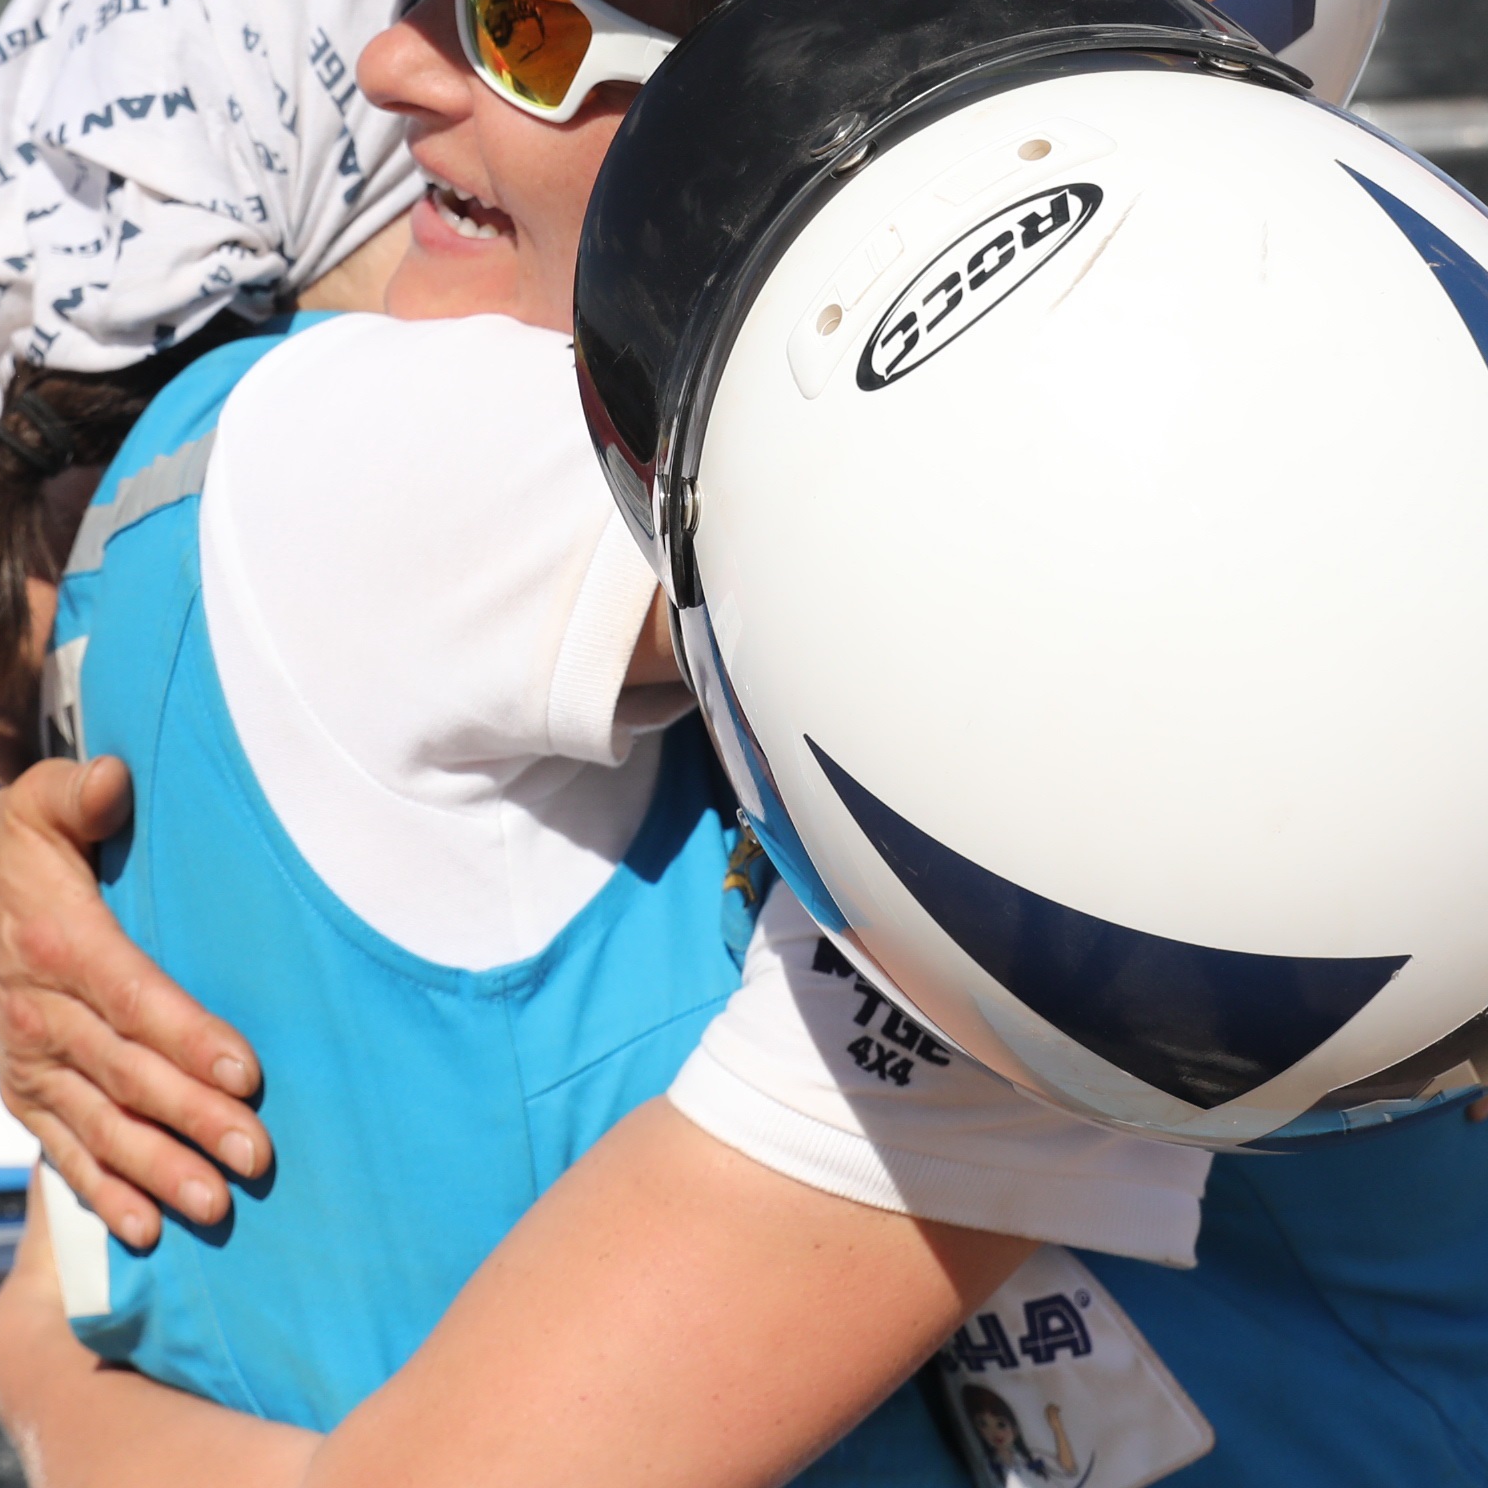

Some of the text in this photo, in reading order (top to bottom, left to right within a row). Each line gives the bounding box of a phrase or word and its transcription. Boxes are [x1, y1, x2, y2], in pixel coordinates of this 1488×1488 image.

[81, 86, 197, 135] MAN
[880, 190, 1072, 379] ROCC
[847, 1035, 914, 1086] 4X4
